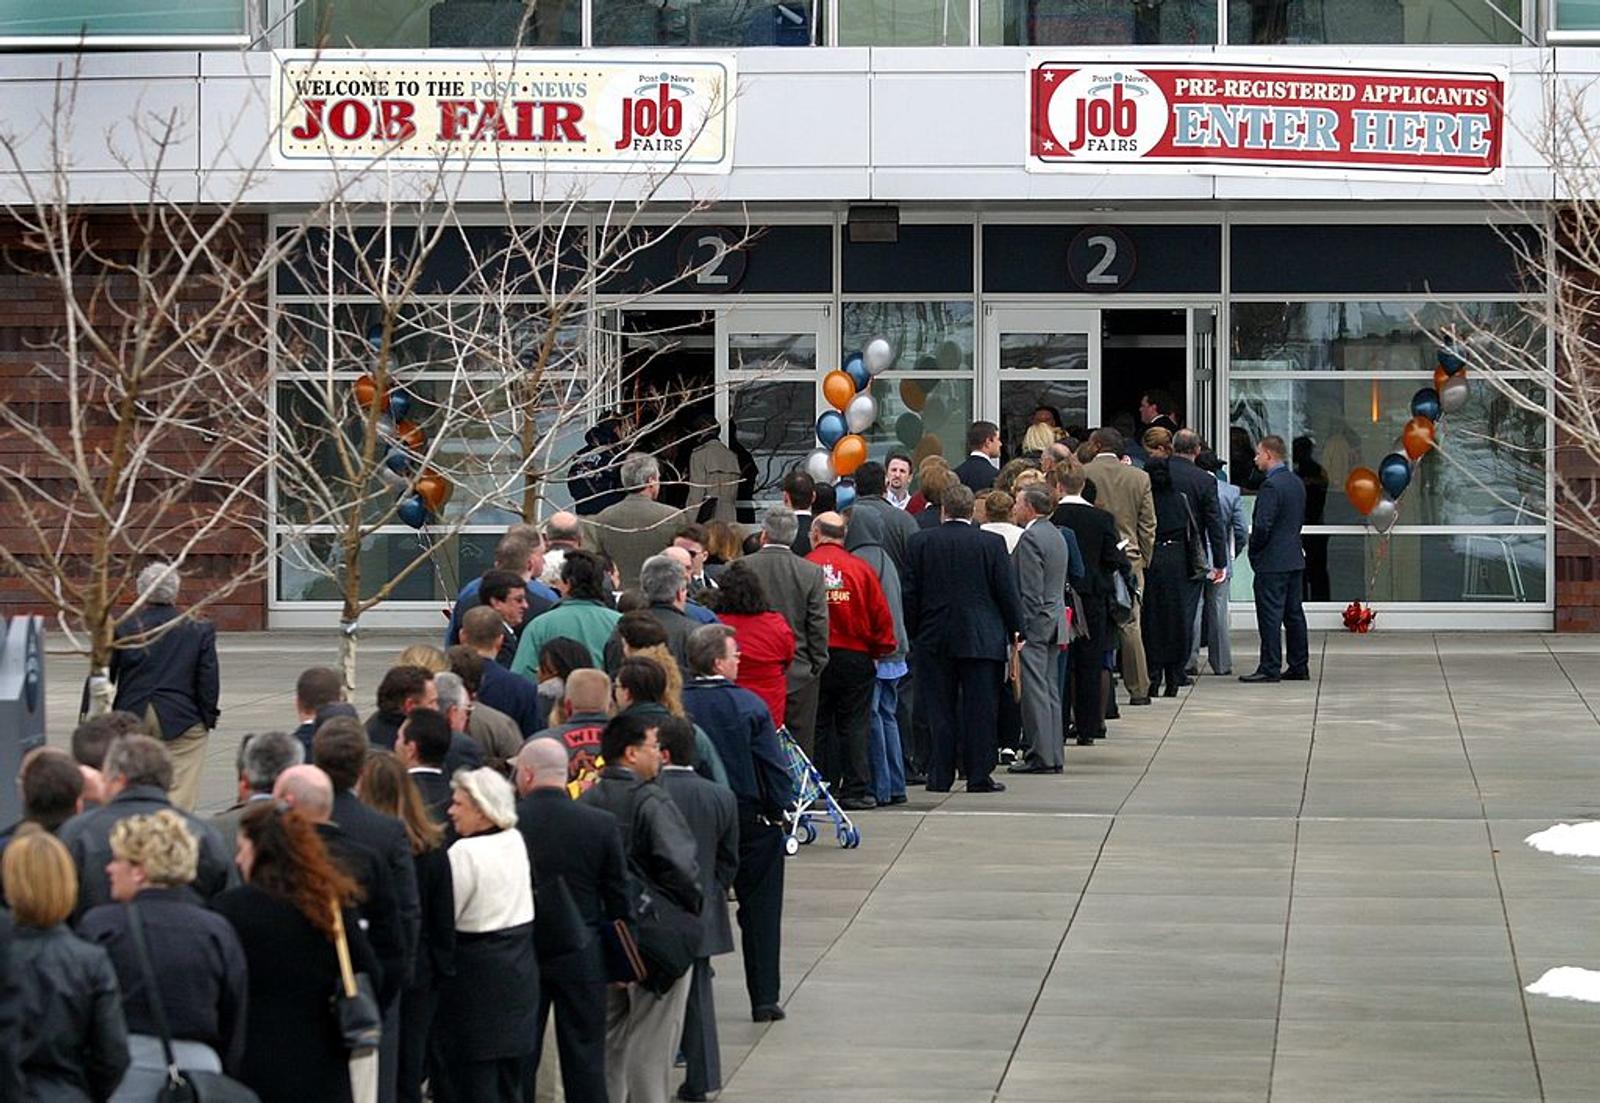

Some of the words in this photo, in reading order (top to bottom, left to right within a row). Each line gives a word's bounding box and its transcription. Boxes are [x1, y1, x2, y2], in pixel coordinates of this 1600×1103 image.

[296, 80, 389, 96] WELCOME
[395, 81, 419, 96] TO
[425, 81, 464, 97] THE
[471, 82, 519, 97] POST
[531, 82, 587, 98] NEWS
[1175, 78, 1356, 102] PRE-REGISTERED
[1361, 84, 1488, 106] APPLICANTS
[291, 98, 417, 140] JOB
[436, 99, 587, 143] FAIR
[1173, 102, 1340, 151] ENTER
[1351, 109, 1492, 158] HERE
[633, 139, 683, 151] FAIRS
[1087, 139, 1138, 151] FAIRS
[698, 236, 728, 284] 2
[1086, 235, 1118, 284] 2
